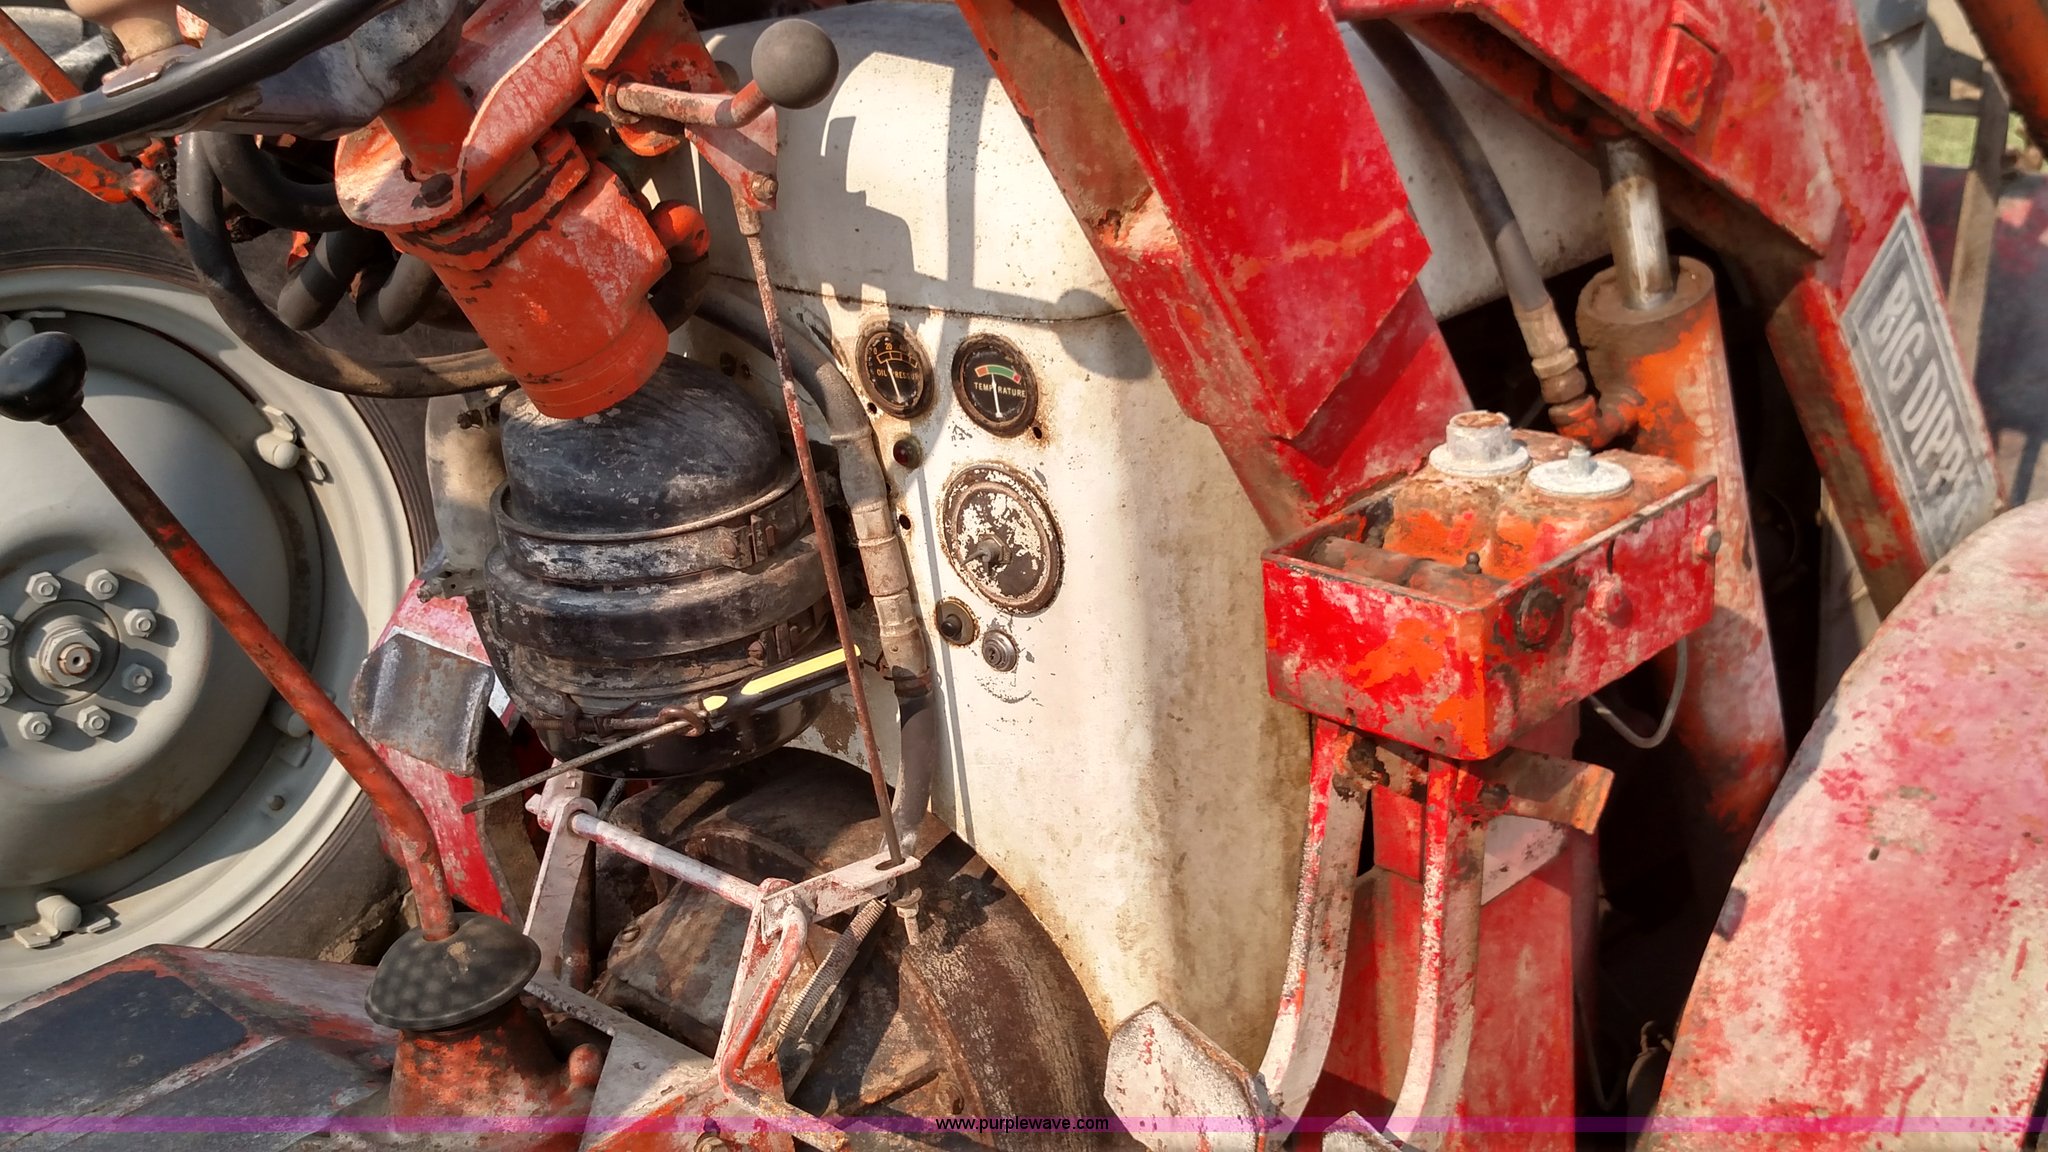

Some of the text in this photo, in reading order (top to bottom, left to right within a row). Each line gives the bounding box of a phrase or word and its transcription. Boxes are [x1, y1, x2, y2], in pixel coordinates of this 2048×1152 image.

[876, 368, 887, 377] OIL
[974, 382, 1026, 398] TEMPRATURE
[1868, 271, 1977, 545] BIG DIPP
